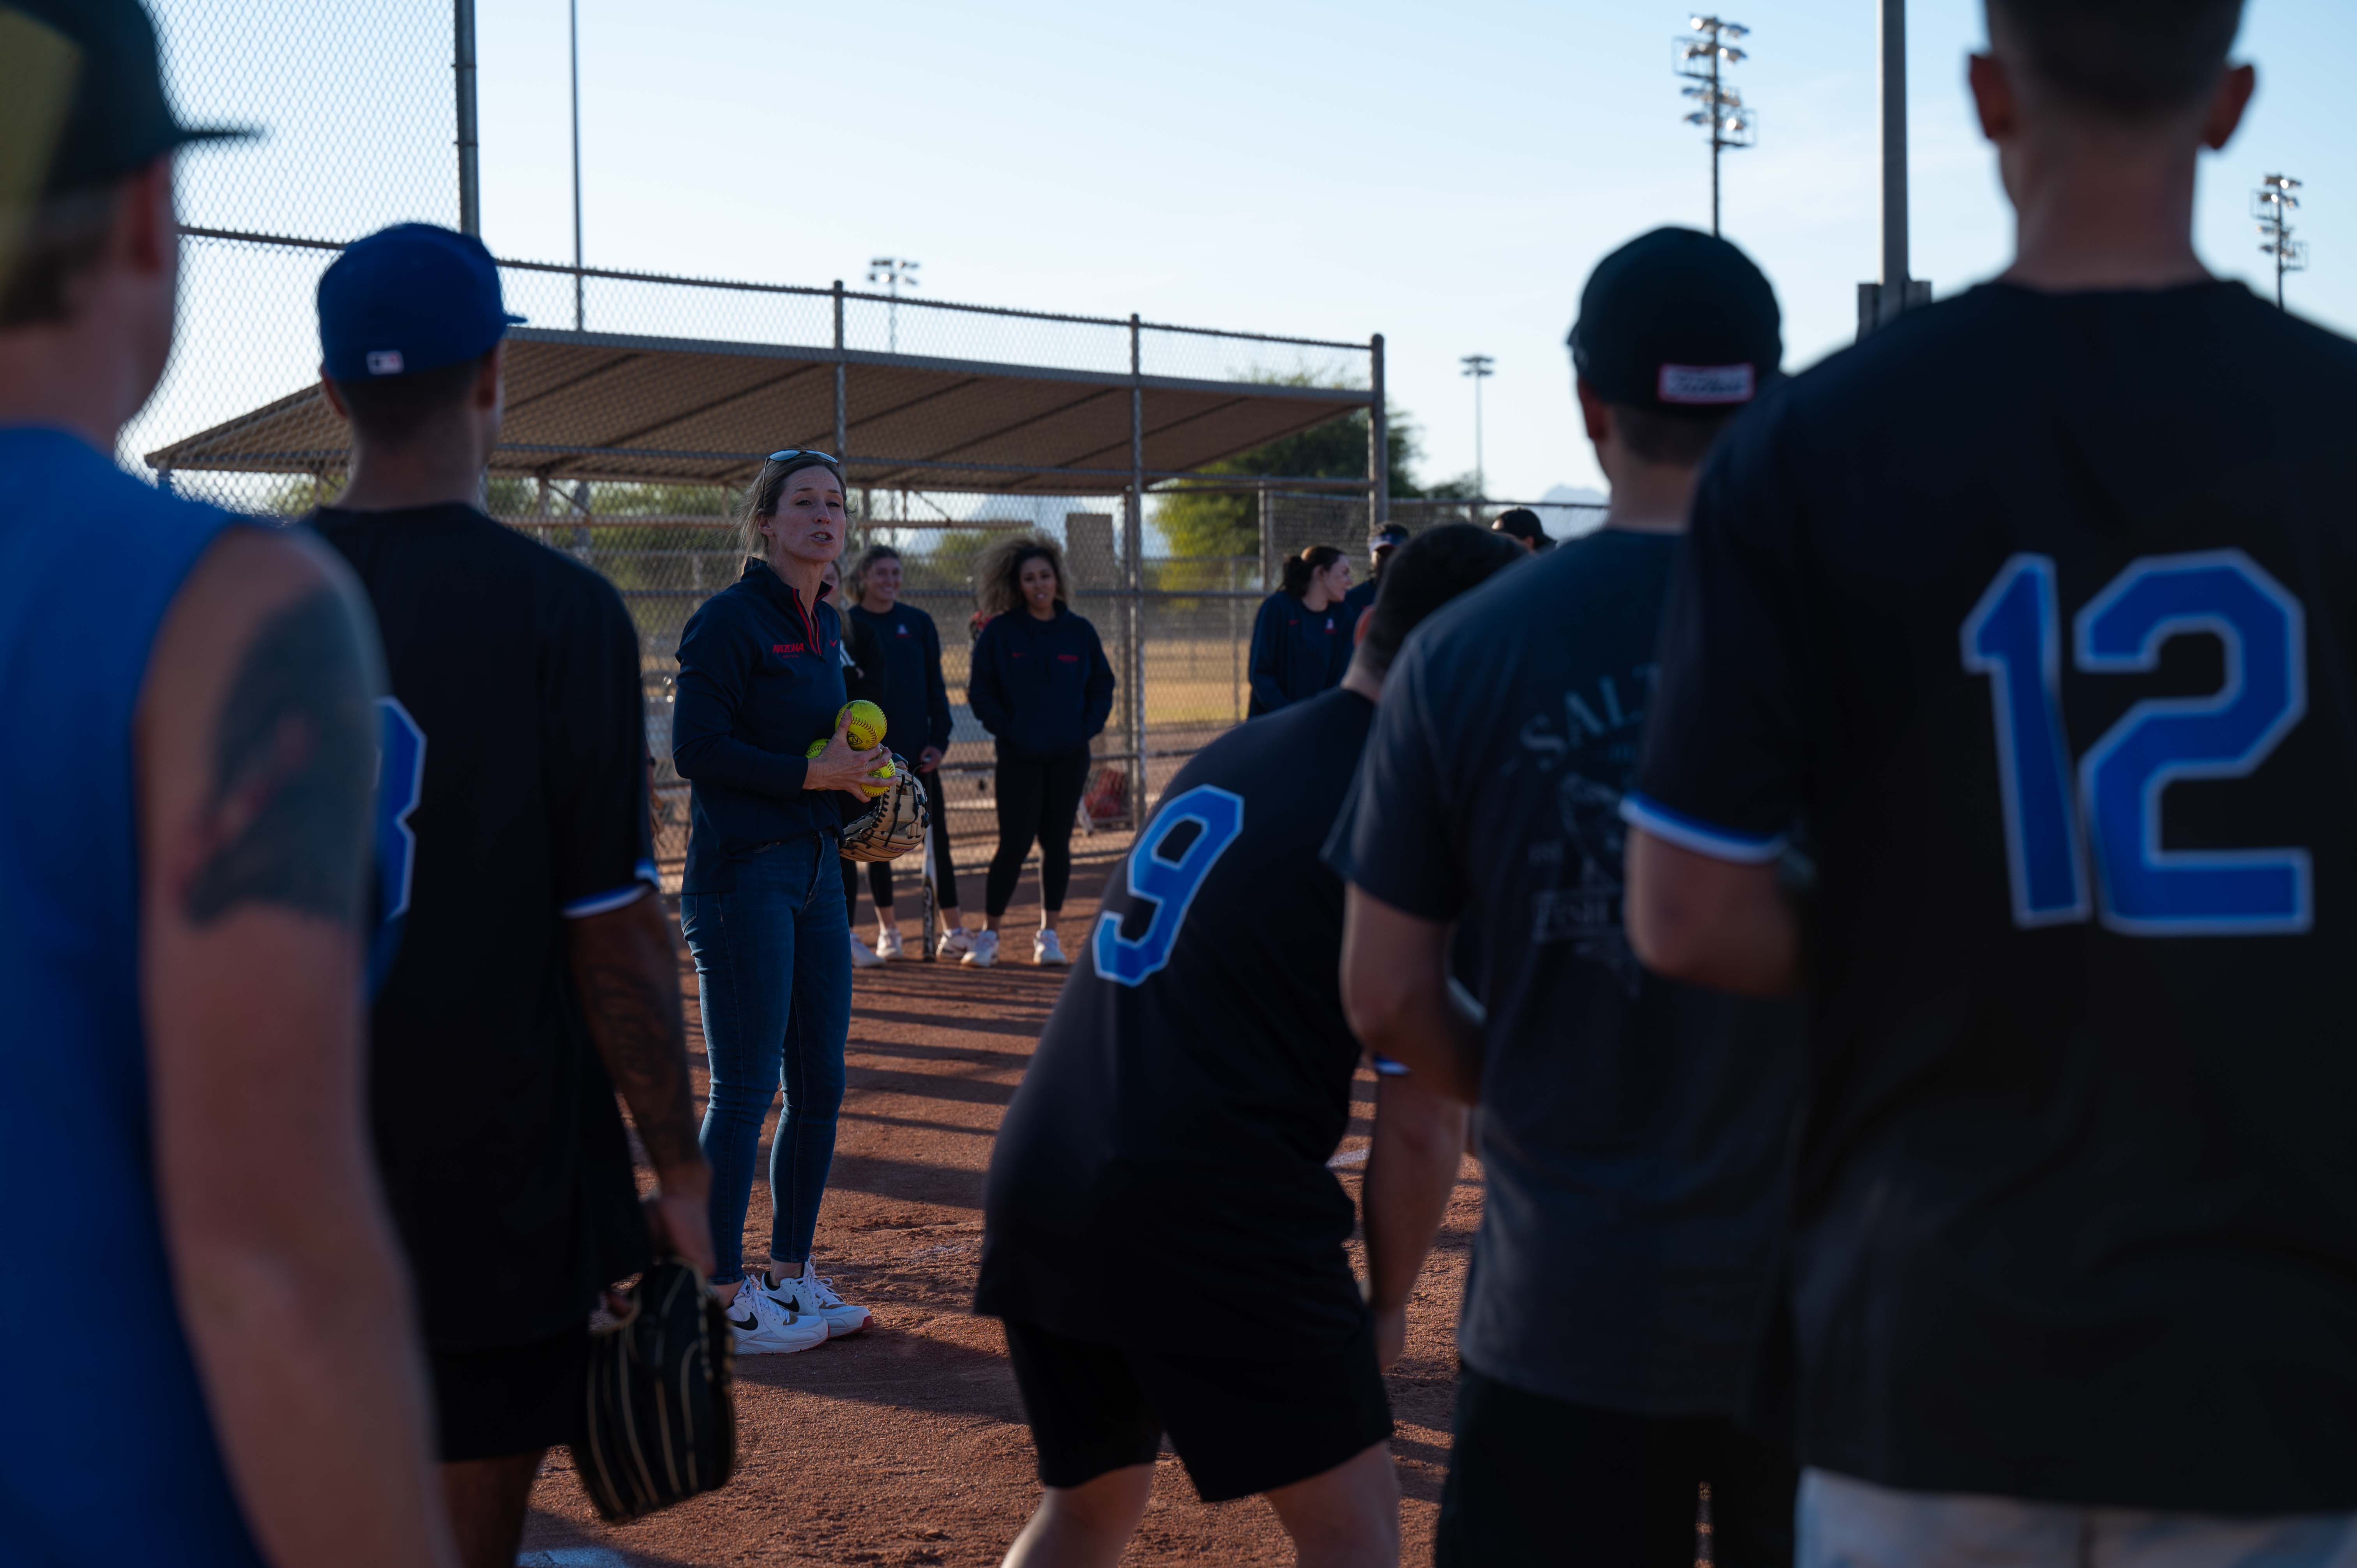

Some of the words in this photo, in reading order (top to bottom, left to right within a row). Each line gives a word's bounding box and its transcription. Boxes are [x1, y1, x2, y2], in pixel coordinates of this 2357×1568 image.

[773, 643, 804, 654] ARIZONA
[1958, 546, 2315, 938] 12
[1092, 783, 1246, 988] 9
